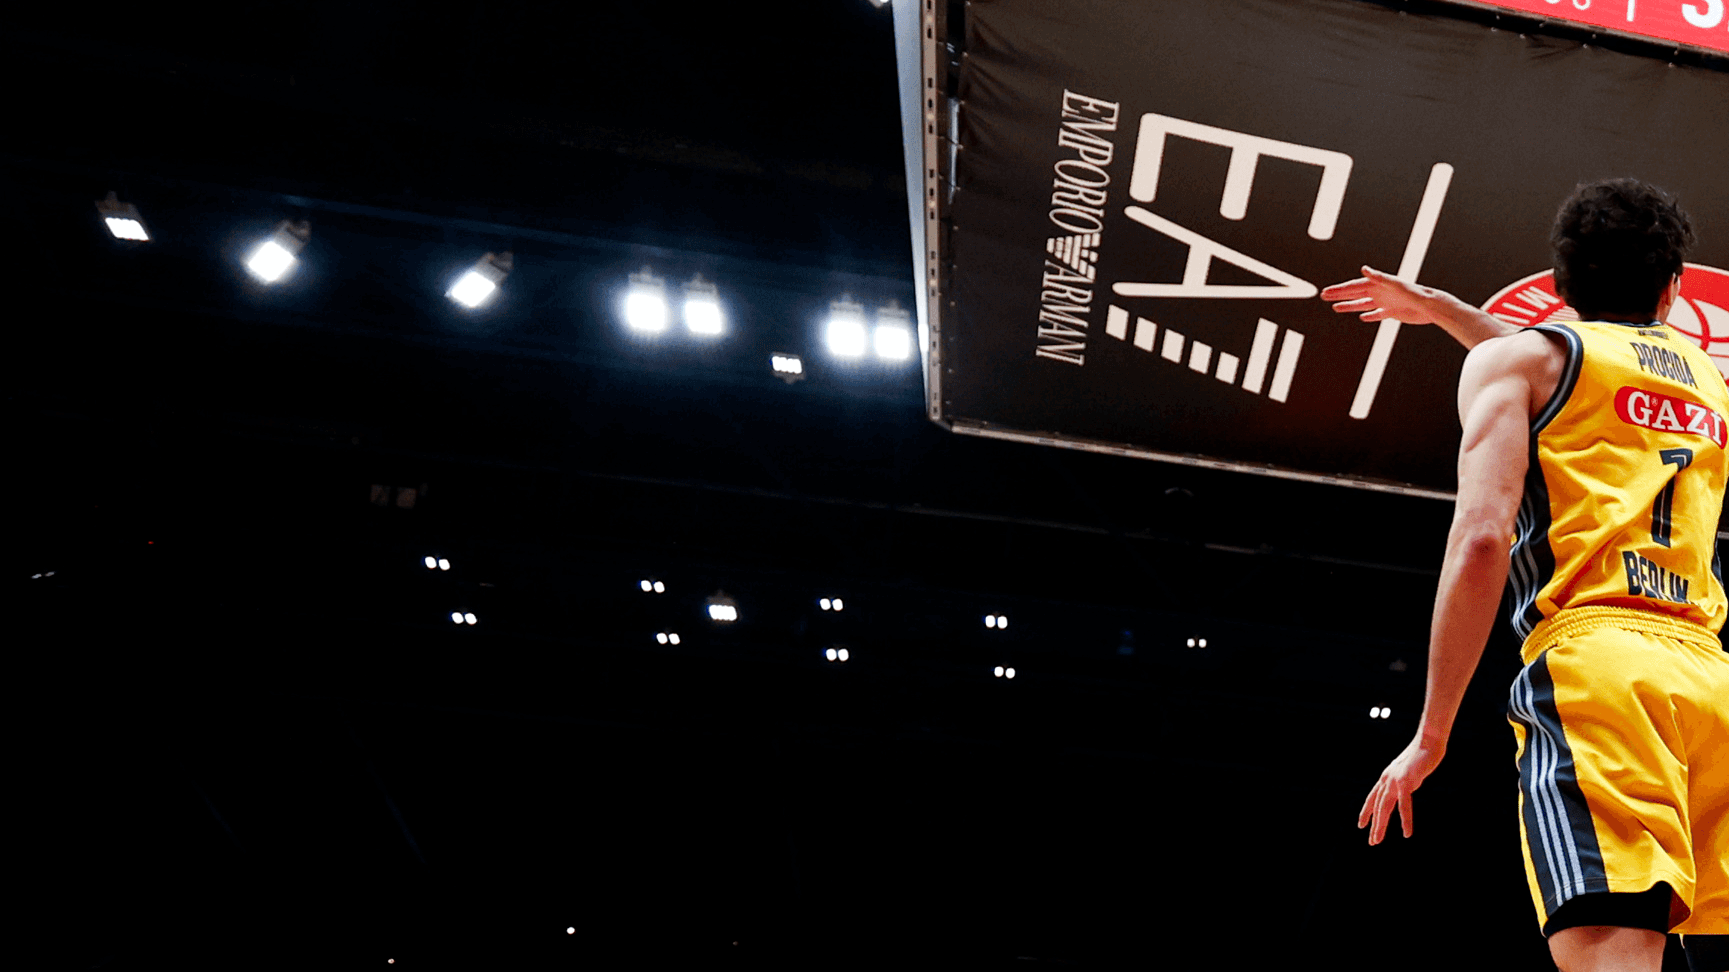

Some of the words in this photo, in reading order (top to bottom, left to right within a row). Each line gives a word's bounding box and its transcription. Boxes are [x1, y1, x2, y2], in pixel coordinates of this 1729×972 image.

[1048, 88, 1121, 236] EMPORIO
[1627, 391, 1722, 447] GAZI
[1658, 448, 1693, 549] 7
[1622, 550, 1692, 605] BERLIN
